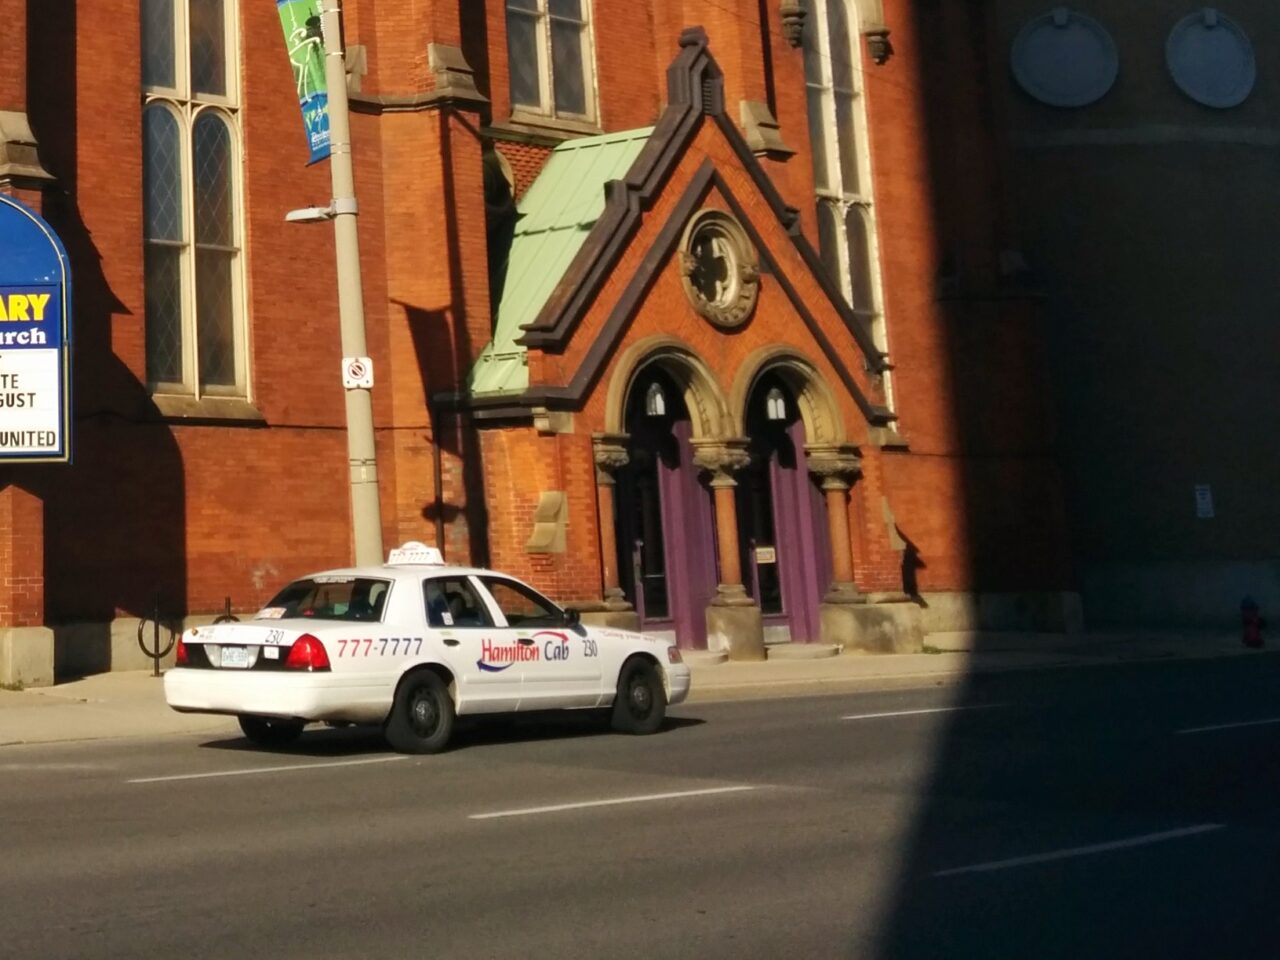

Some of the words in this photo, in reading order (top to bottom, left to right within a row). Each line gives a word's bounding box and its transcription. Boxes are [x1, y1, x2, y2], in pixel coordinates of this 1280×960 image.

[0, 430, 56, 446] UNITED
[264, 629, 285, 645] 230
[337, 638, 423, 658] 777-7777
[482, 639, 540, 663] Hamilton
[544, 640, 569, 661] Cab
[583, 639, 598, 657] 230
